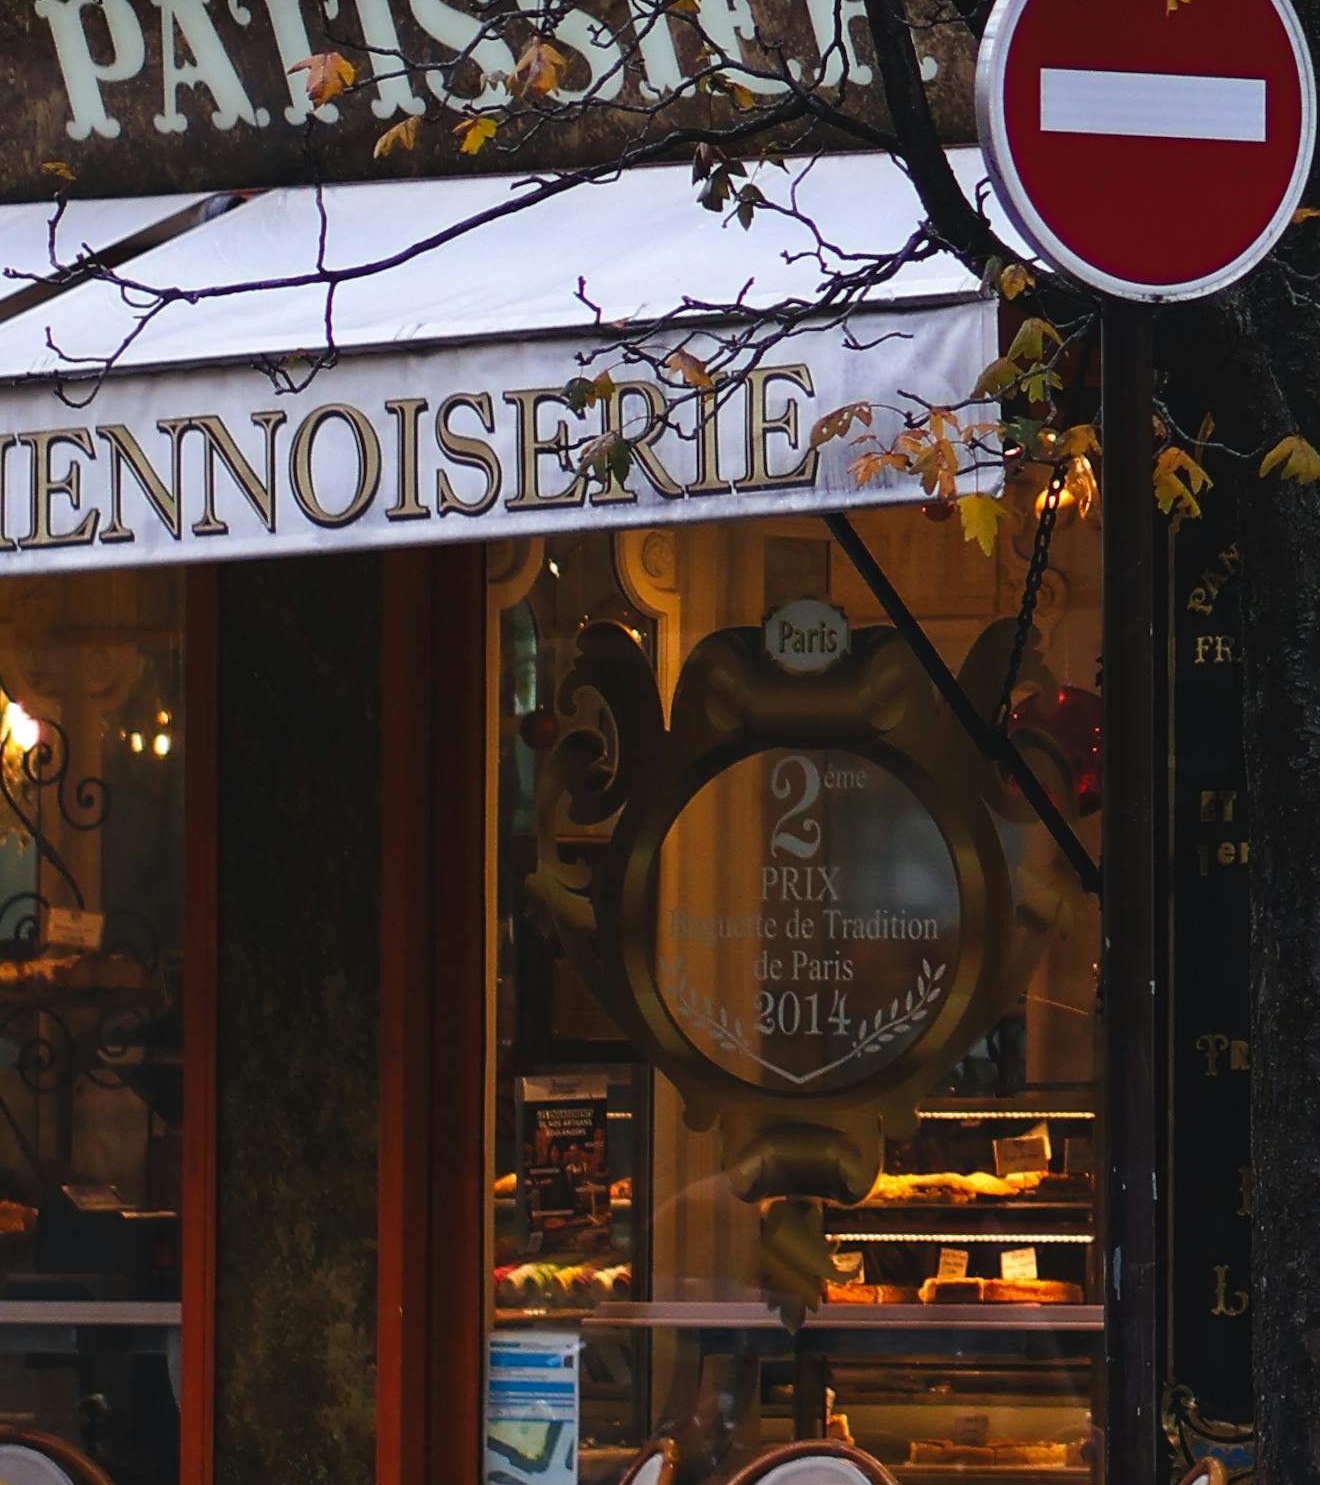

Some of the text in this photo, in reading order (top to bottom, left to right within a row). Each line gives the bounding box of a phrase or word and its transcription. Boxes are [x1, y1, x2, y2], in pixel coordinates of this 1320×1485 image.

[778, 620, 838, 654] Paris
[760, 866, 841, 902] PRIX
[785, 909, 815, 940] de
[823, 908, 939, 940] Tradition
[753, 950, 854, 981] de Paris
[754, 989, 852, 1037] 2014
